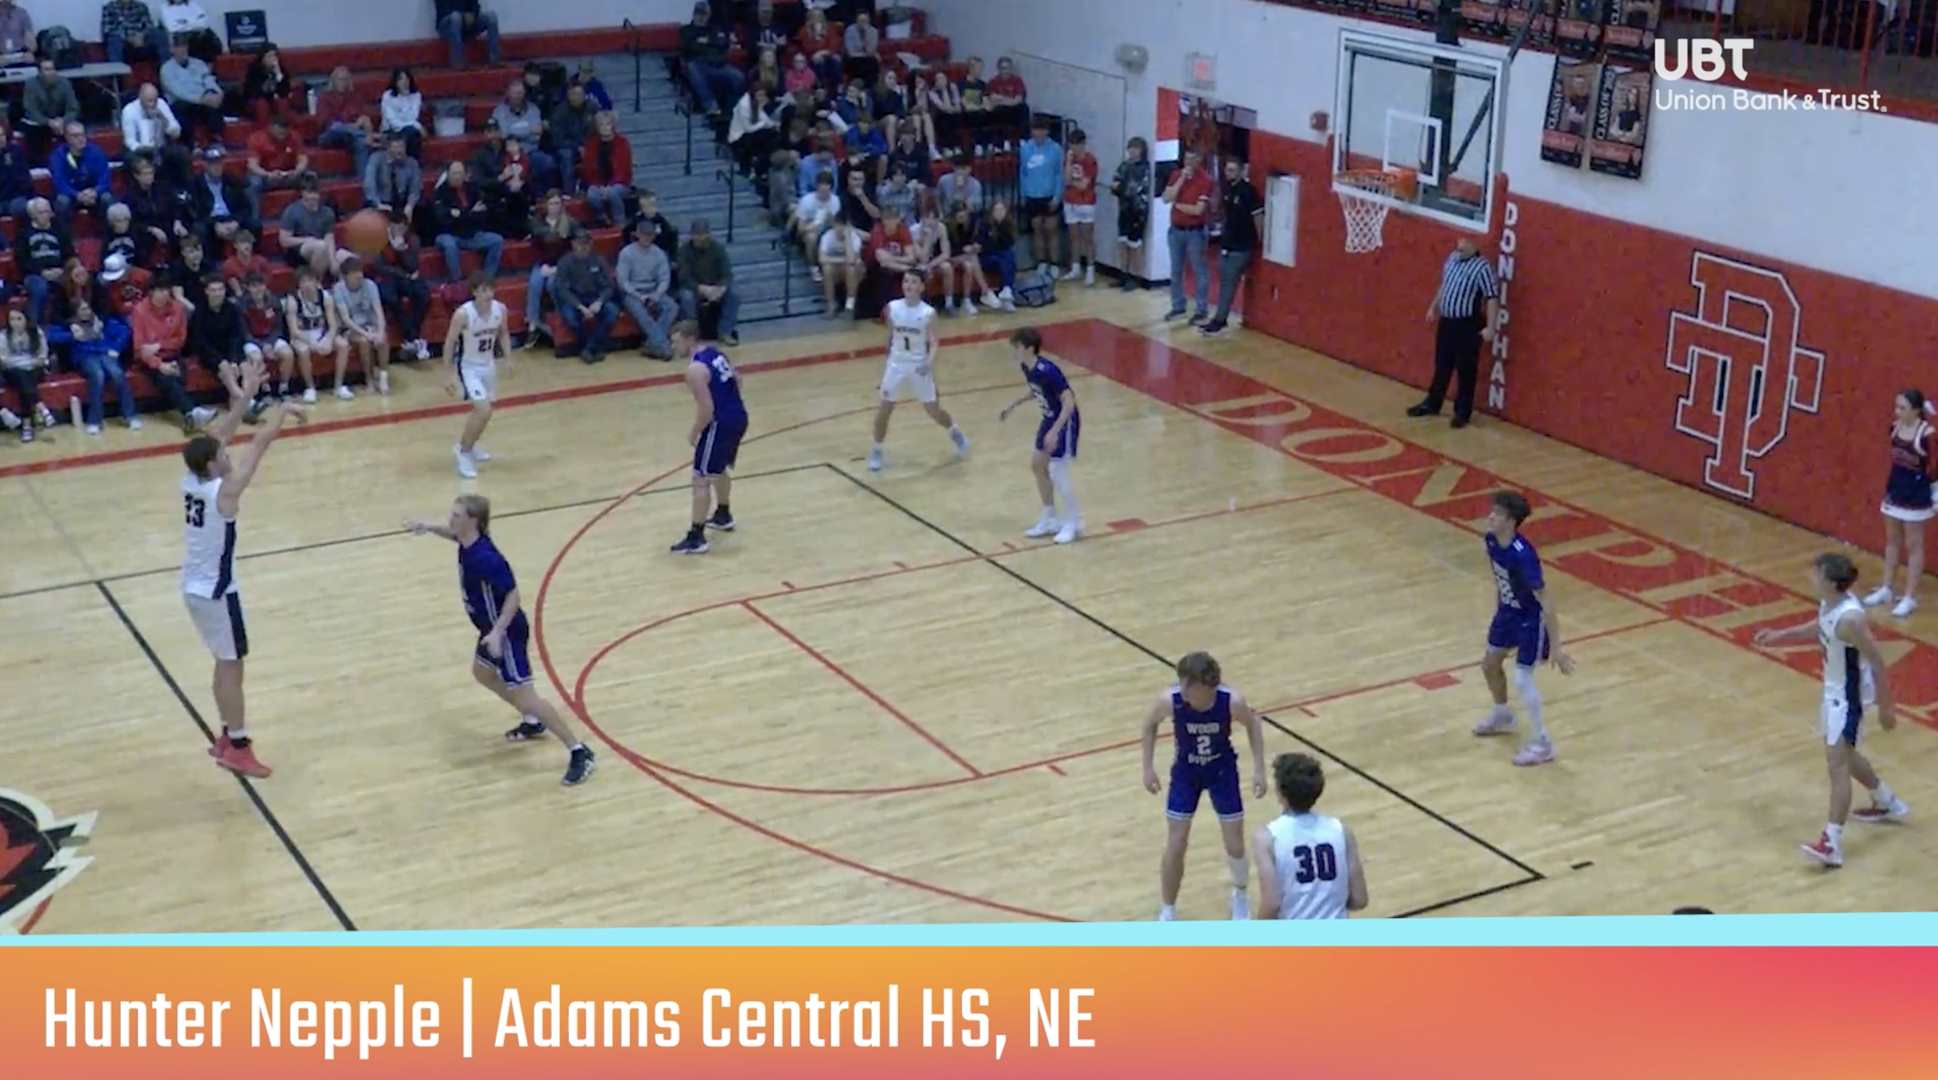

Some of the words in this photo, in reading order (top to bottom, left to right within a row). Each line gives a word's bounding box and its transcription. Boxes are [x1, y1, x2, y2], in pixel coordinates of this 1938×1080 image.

[1488, 200, 1519, 411] DONIPHAN
[1196, 735, 1211, 755] 2
[1293, 842, 1337, 884] 30
